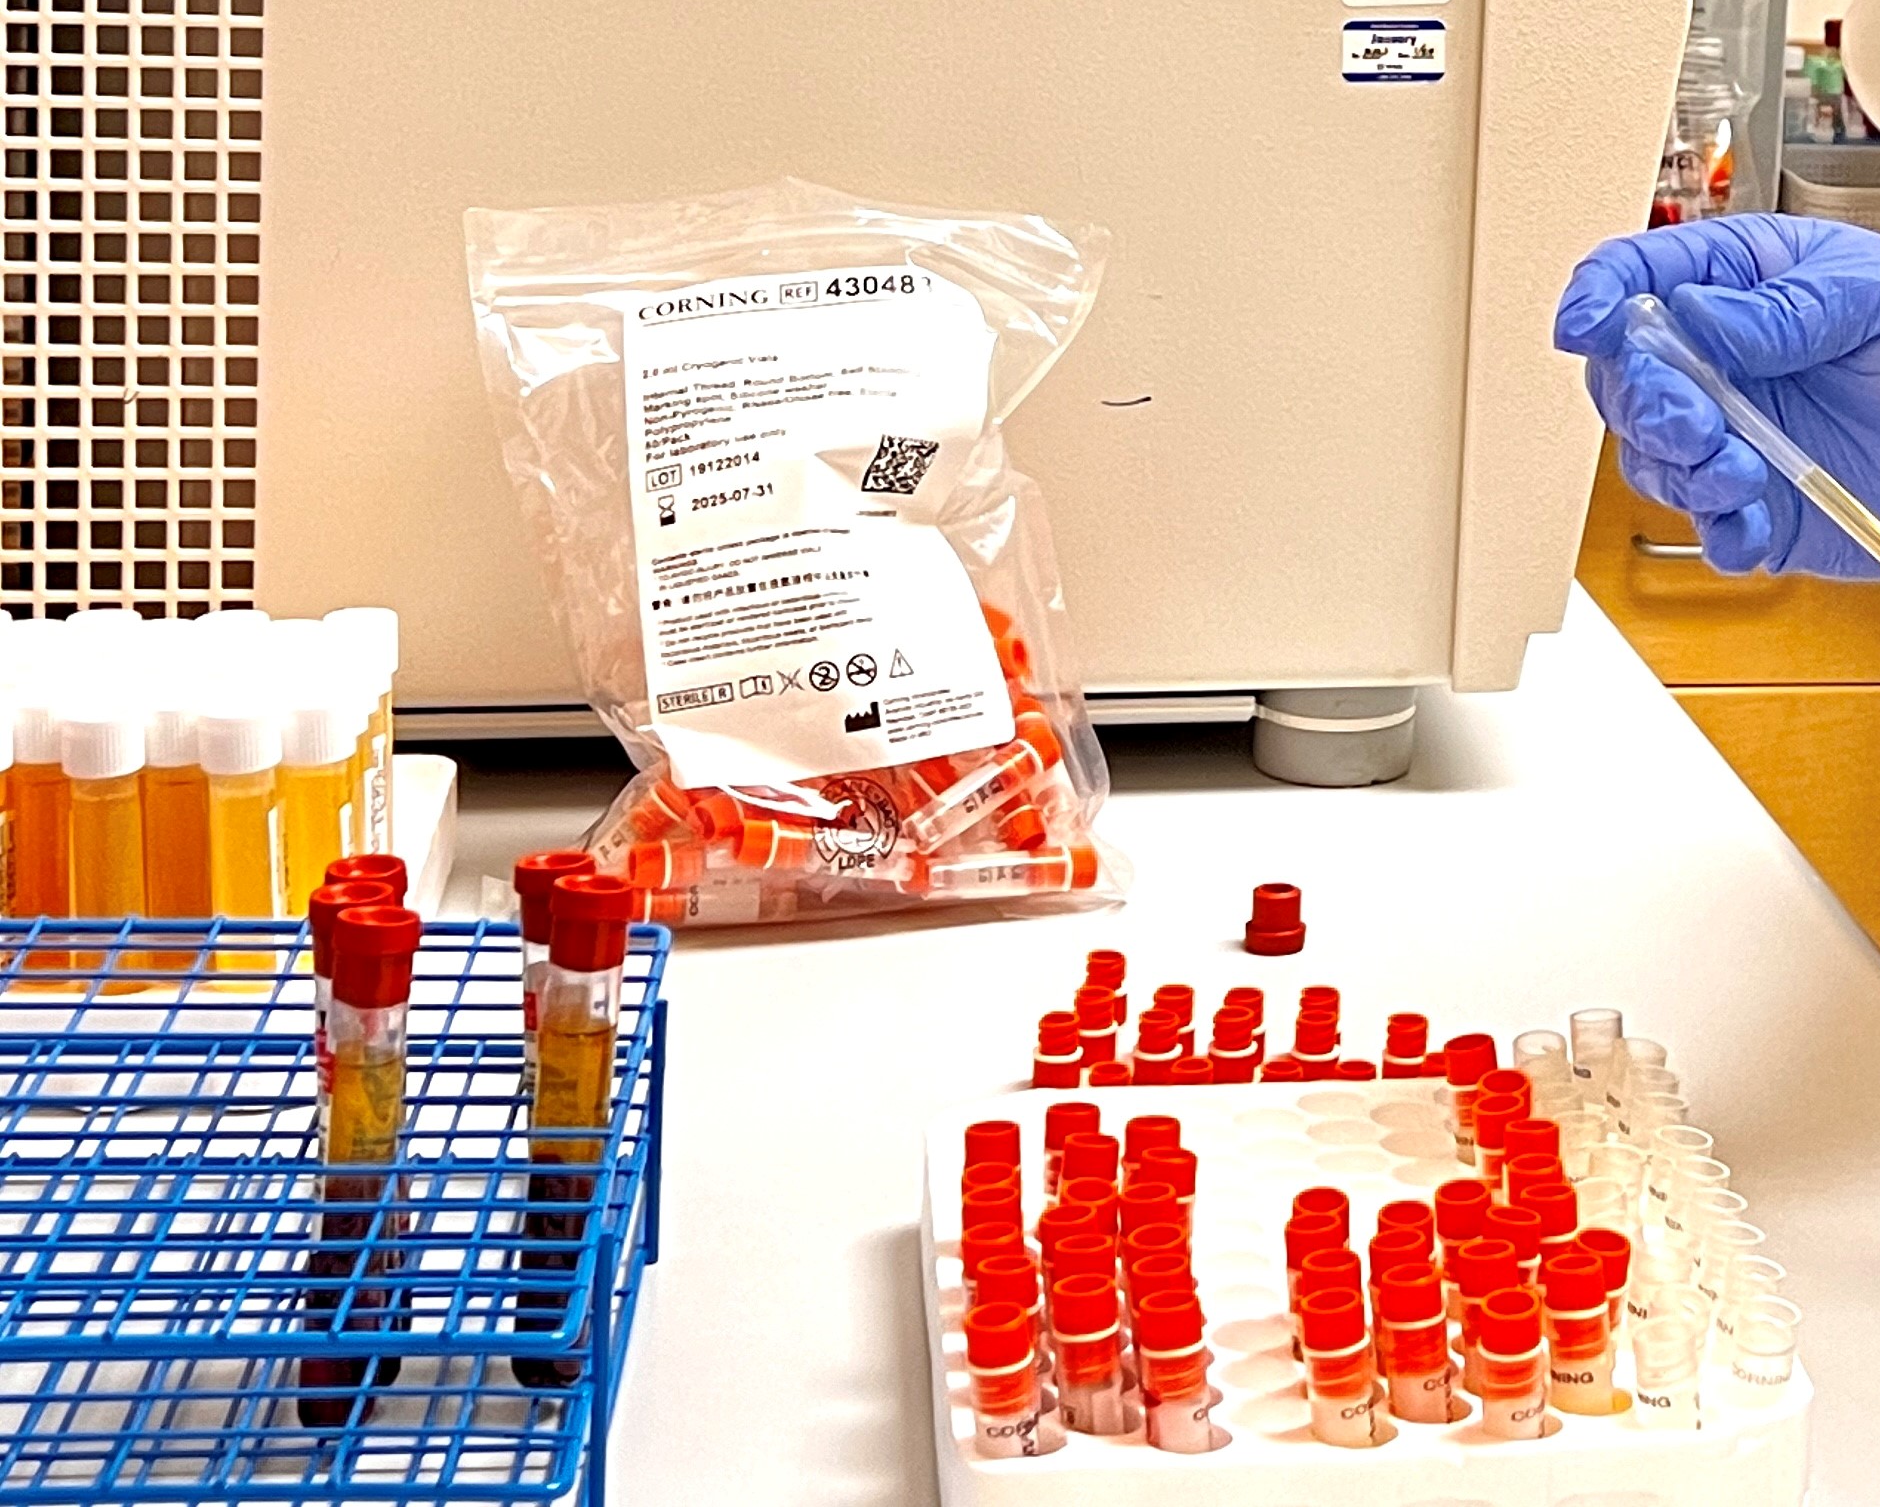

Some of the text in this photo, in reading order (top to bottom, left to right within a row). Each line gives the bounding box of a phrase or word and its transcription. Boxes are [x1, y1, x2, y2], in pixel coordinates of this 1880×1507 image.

[639, 289, 768, 321] CORNING
[784, 285, 813, 300] REF
[652, 451, 760, 488] LOT 19122014
[692, 482, 774, 512] 2025-07-31
[839, 855, 875, 870] LDPE
